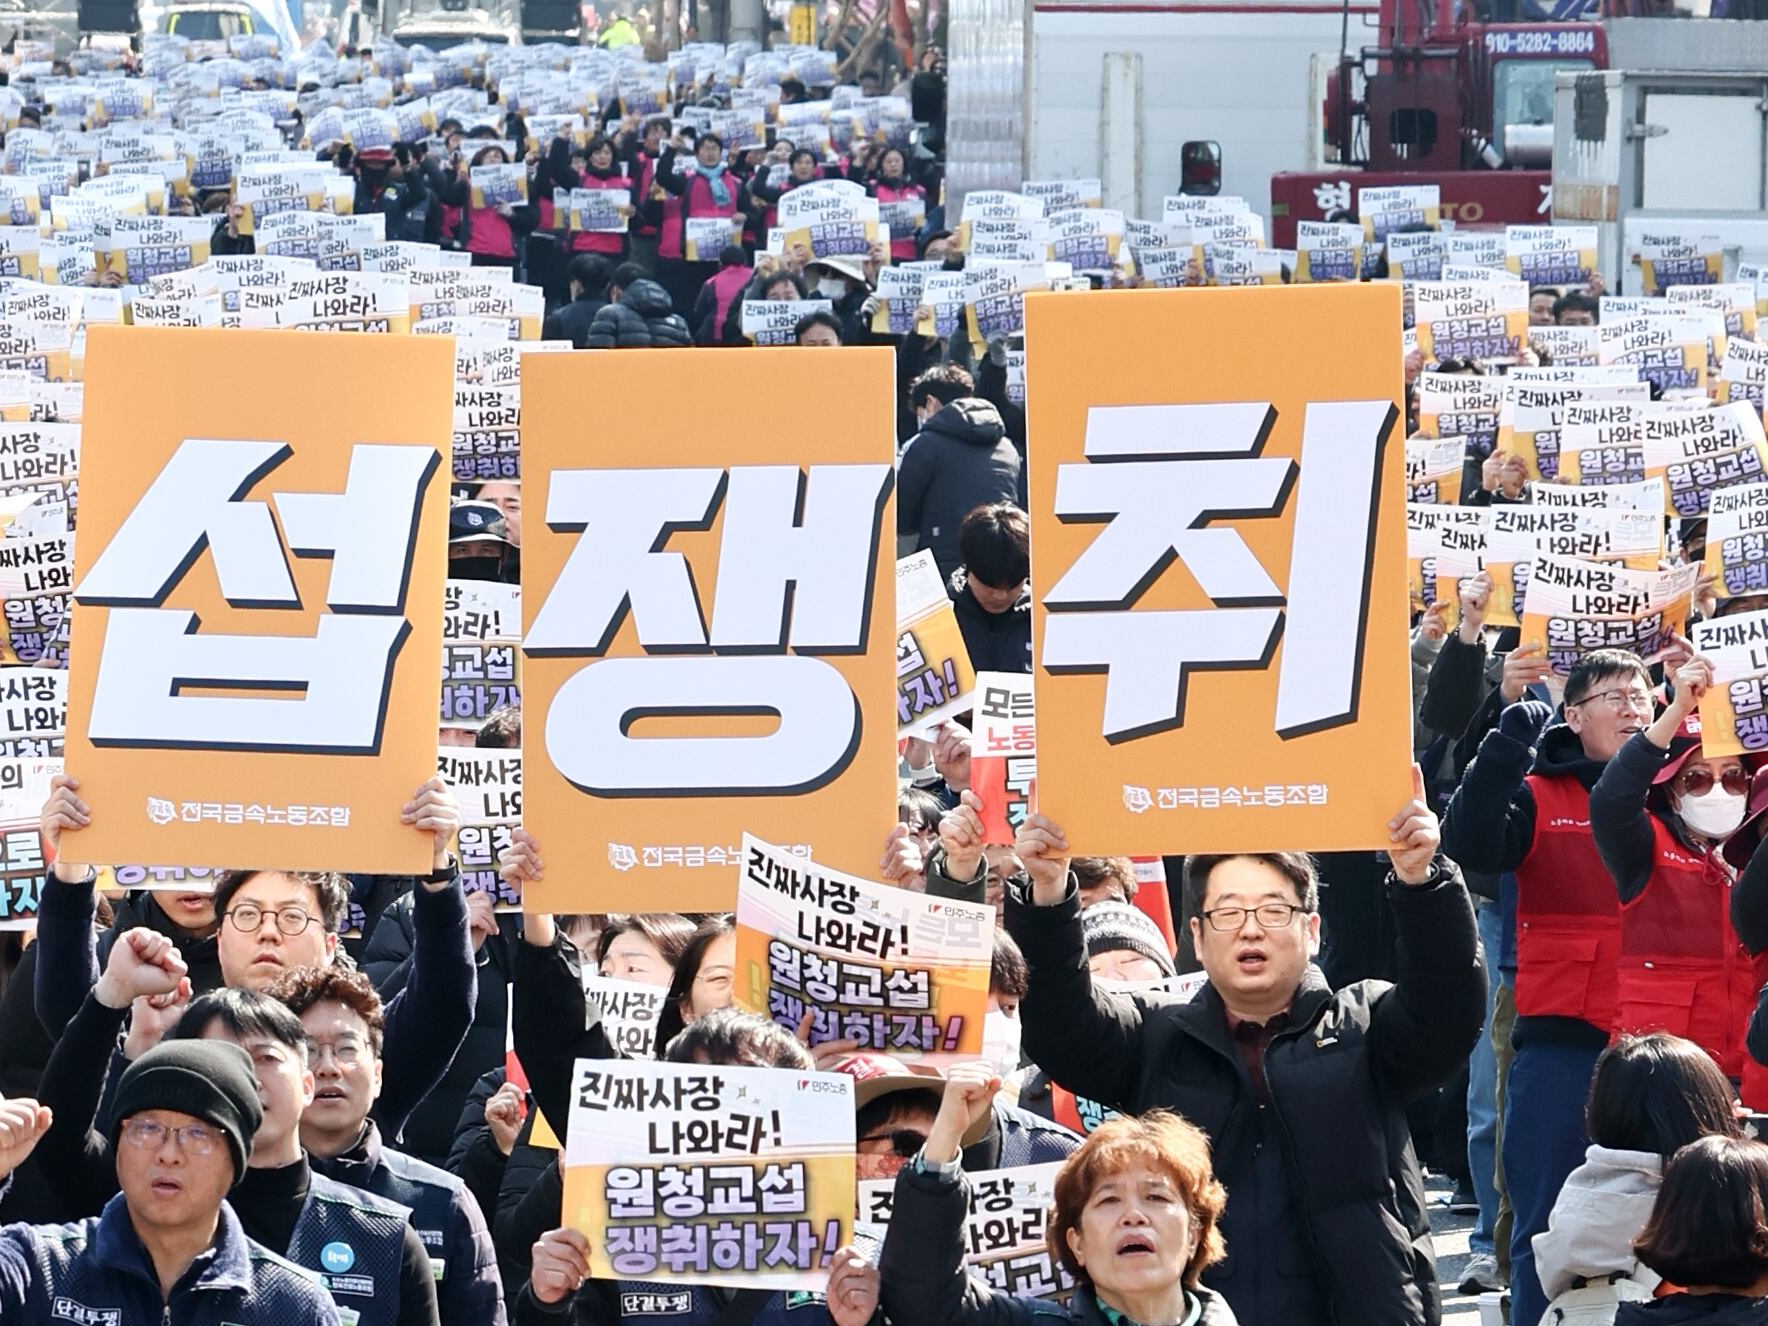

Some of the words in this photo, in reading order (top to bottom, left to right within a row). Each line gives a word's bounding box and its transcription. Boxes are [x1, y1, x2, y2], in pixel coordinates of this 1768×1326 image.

[289, 276, 348, 301] 진짜사장
[313, 292, 377, 317] 나와라!
[1418, 286, 1472, 301] 진짜사장
[1445, 299, 1496, 317] 나와라!
[1431, 315, 1508, 340] 원청교섭
[452, 430, 520, 455] 원청교
[1645, 414, 1715, 439] 진짜사장
[1682, 424, 1745, 456] 나와라!
[1, 449, 78, 481] 나와라!
[1666, 446, 1762, 490] 원청교섭
[1495, 511, 1578, 533] 진짜사장
[1535, 557, 1615, 592] 진짜사장
[73, 438, 443, 756] 섭
[522, 464, 895, 799] 쟁
[1042, 400, 1401, 745] 취
[1573, 592, 1649, 617] 나와라!
[1547, 613, 1664, 648] 원청교섭
[1156, 782, 1329, 808] 전국금속노동조합
[181, 801, 351, 827] 전국금속노동조합
[746, 845, 860, 916] 진짜사장
[797, 912, 910, 960] 나와라!
[766, 938, 932, 1011] 원청교섭
[766, 991, 964, 1053] 쟁취하자!
[580, 1072, 723, 1112] 진짜사장
[648, 1110, 781, 1155] 나와라!
[604, 1161, 808, 1220] 원청교섭
[604, 1219, 839, 1276] 쟁취하자!
[623, 1294, 690, 1314] 단결투쟁
